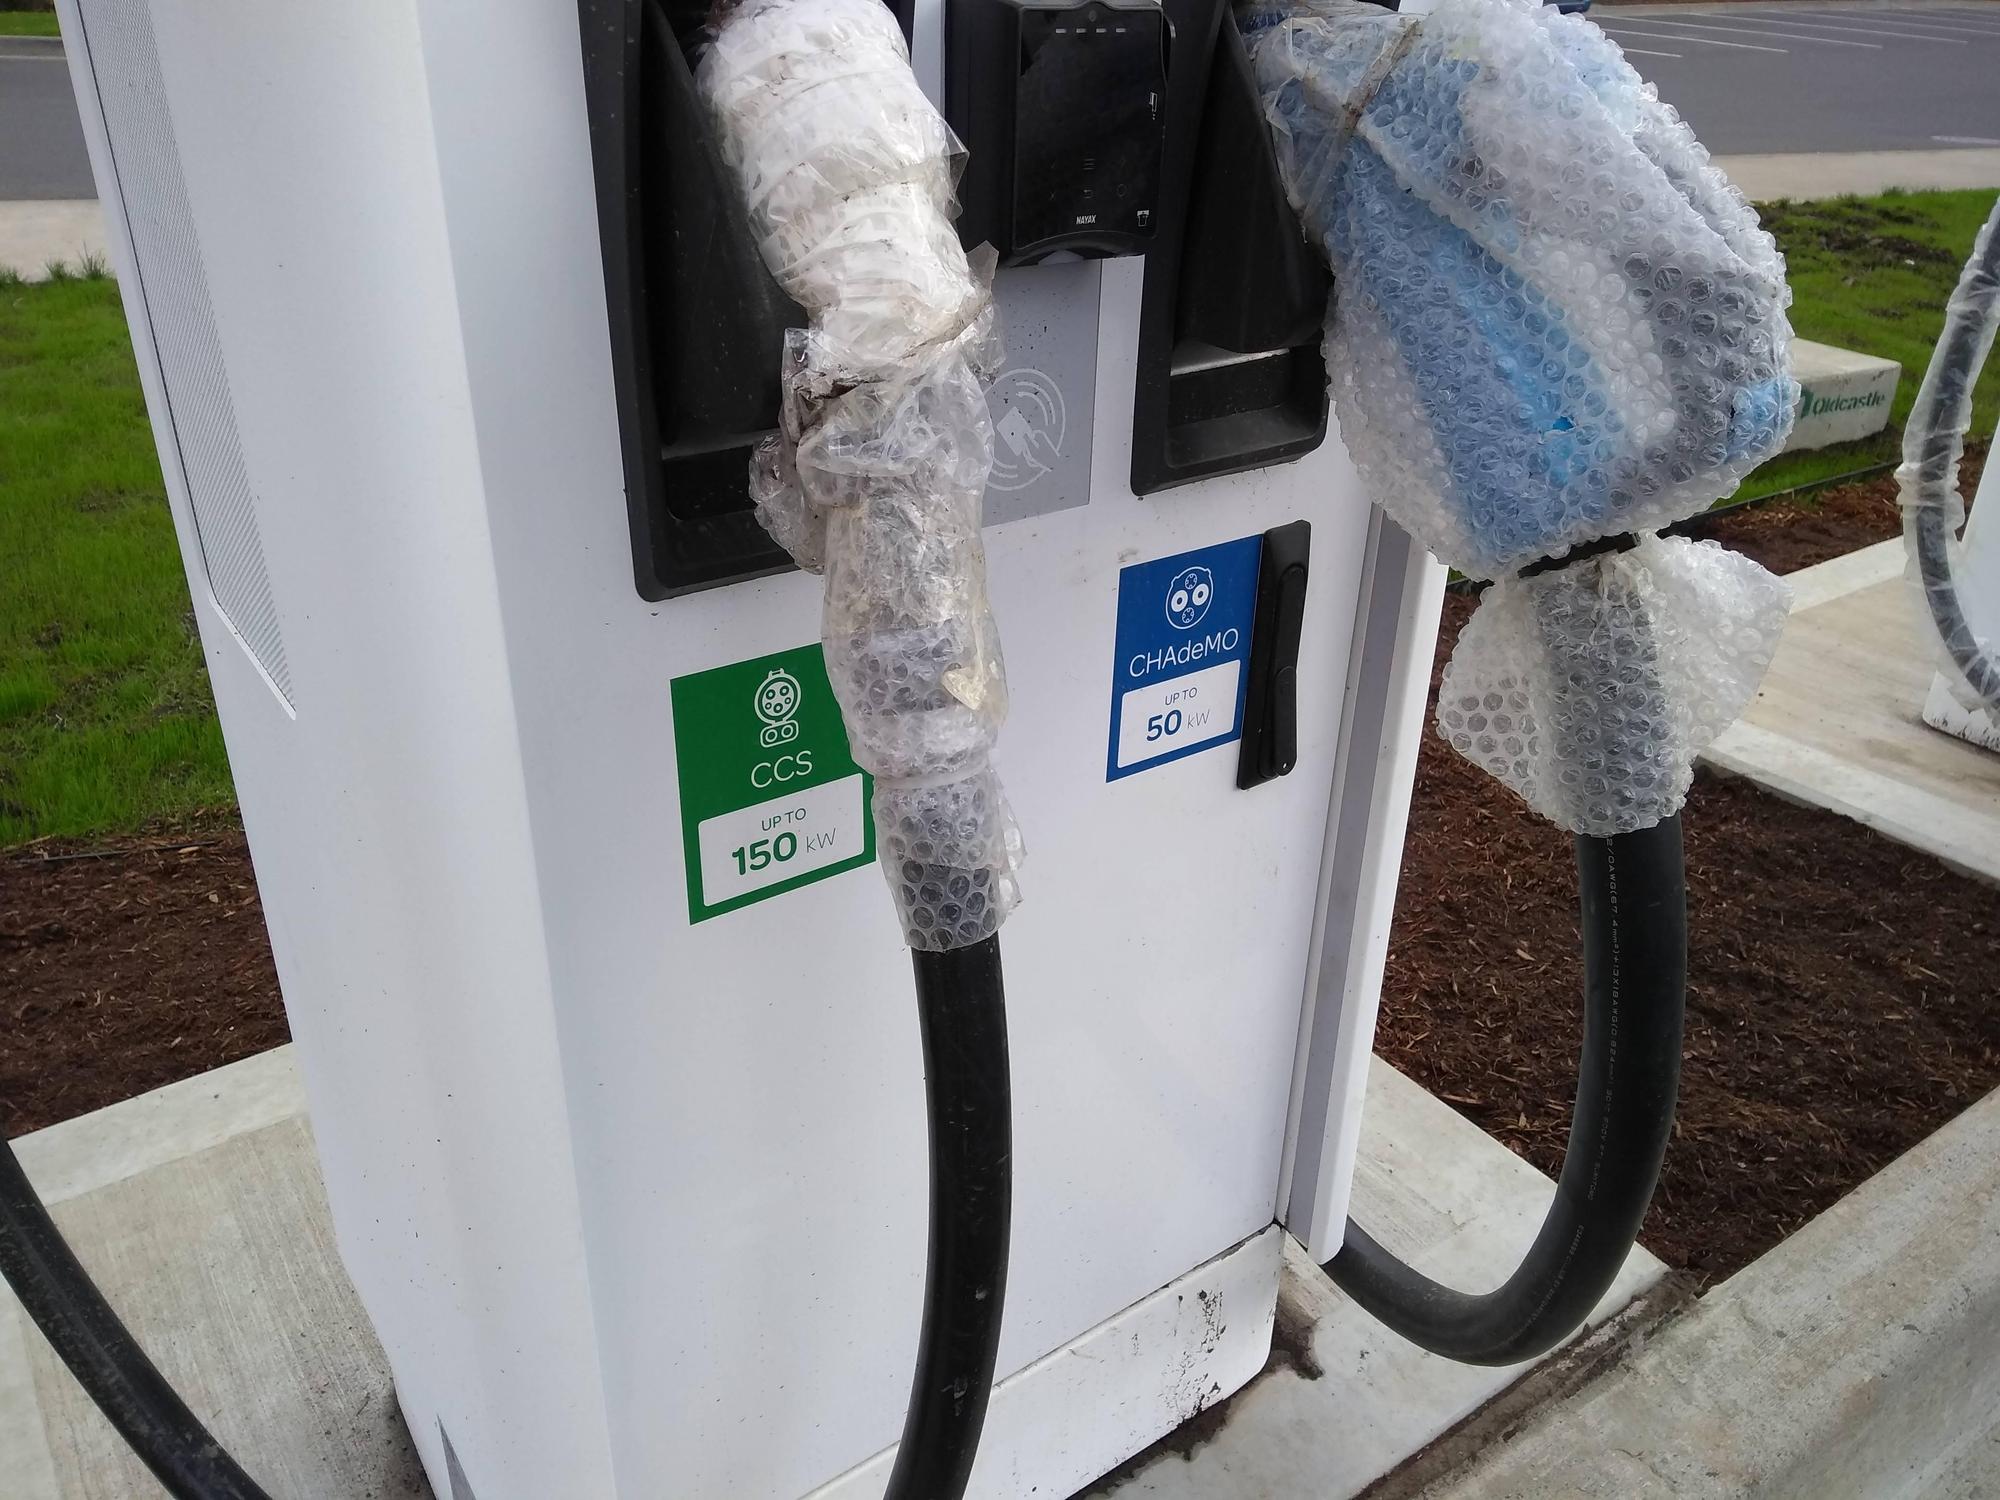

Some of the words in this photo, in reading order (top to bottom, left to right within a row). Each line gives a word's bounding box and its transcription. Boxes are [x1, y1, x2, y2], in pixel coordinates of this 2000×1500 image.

[1076, 214, 1097, 225] NAYAX
[1813, 391, 1885, 416] Oldcastle
[1129, 628, 1239, 678] CHAdeMO
[1164, 692, 1180, 706] UP
[1182, 687, 1198, 701] TO
[1146, 709, 1182, 742] 50
[1187, 709, 1210, 729] kW
[751, 750, 813, 788] CCS
[761, 815, 782, 831] UP
[785, 807, 807, 825] TO
[731, 831, 798, 876] 150
[805, 828, 836, 853] kW
